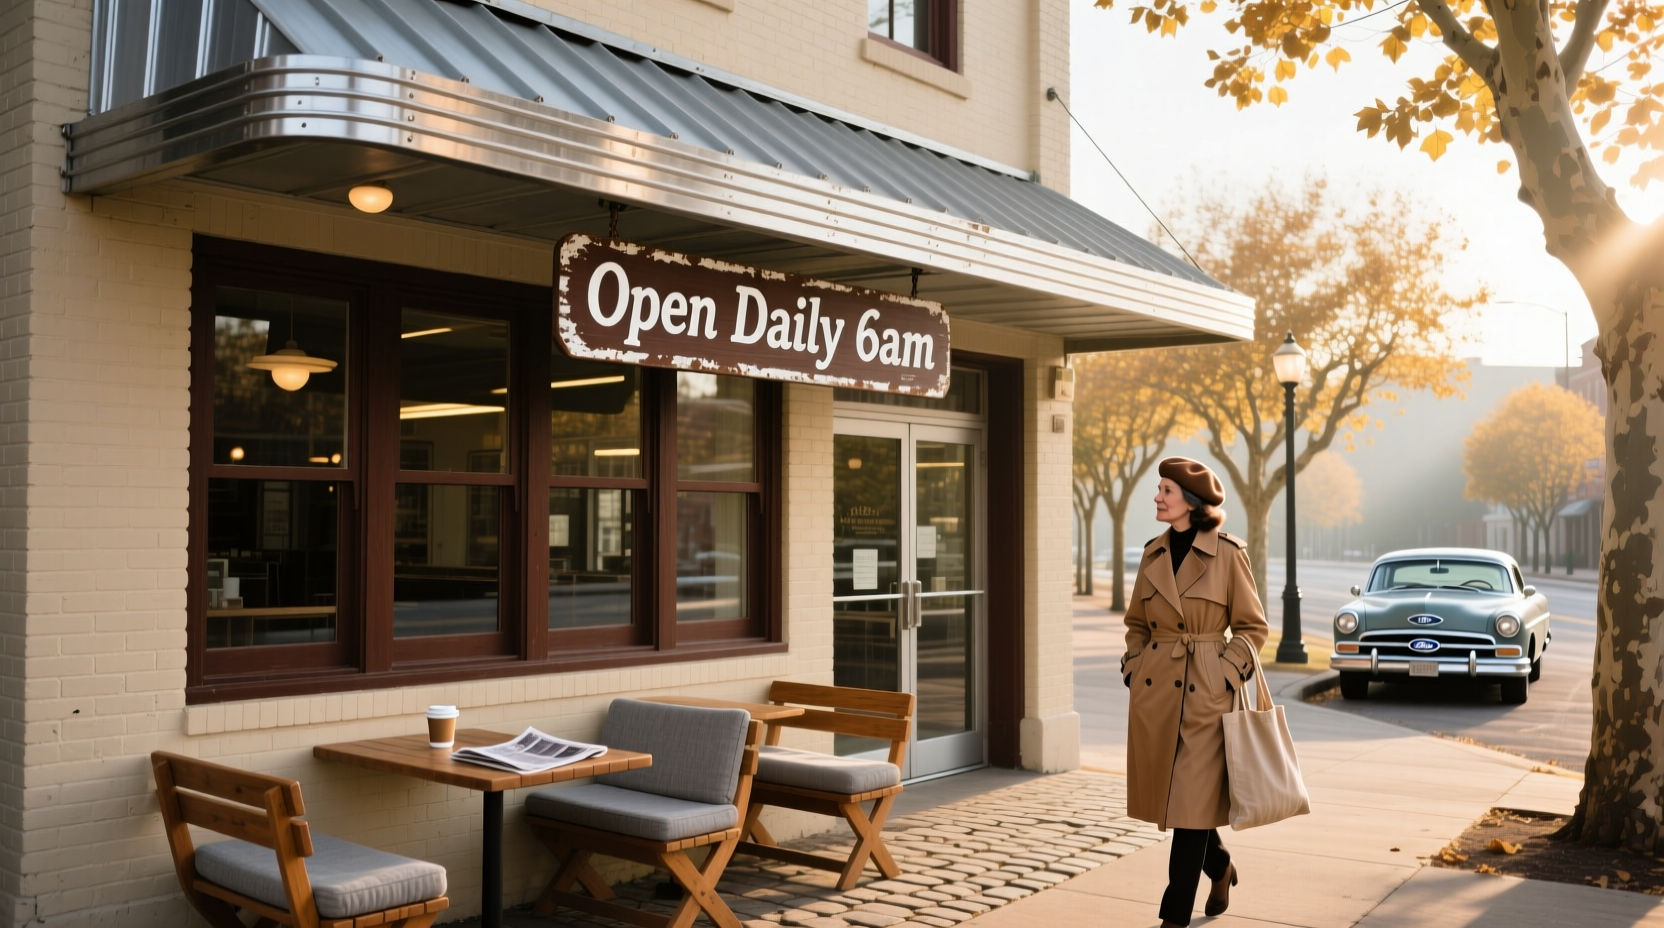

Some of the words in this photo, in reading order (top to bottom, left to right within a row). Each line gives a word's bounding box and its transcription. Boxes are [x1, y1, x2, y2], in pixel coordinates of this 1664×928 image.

[588, 261, 717, 347] Open
[730, 285, 845, 370] Daily
[856, 309, 934, 370] 6am
